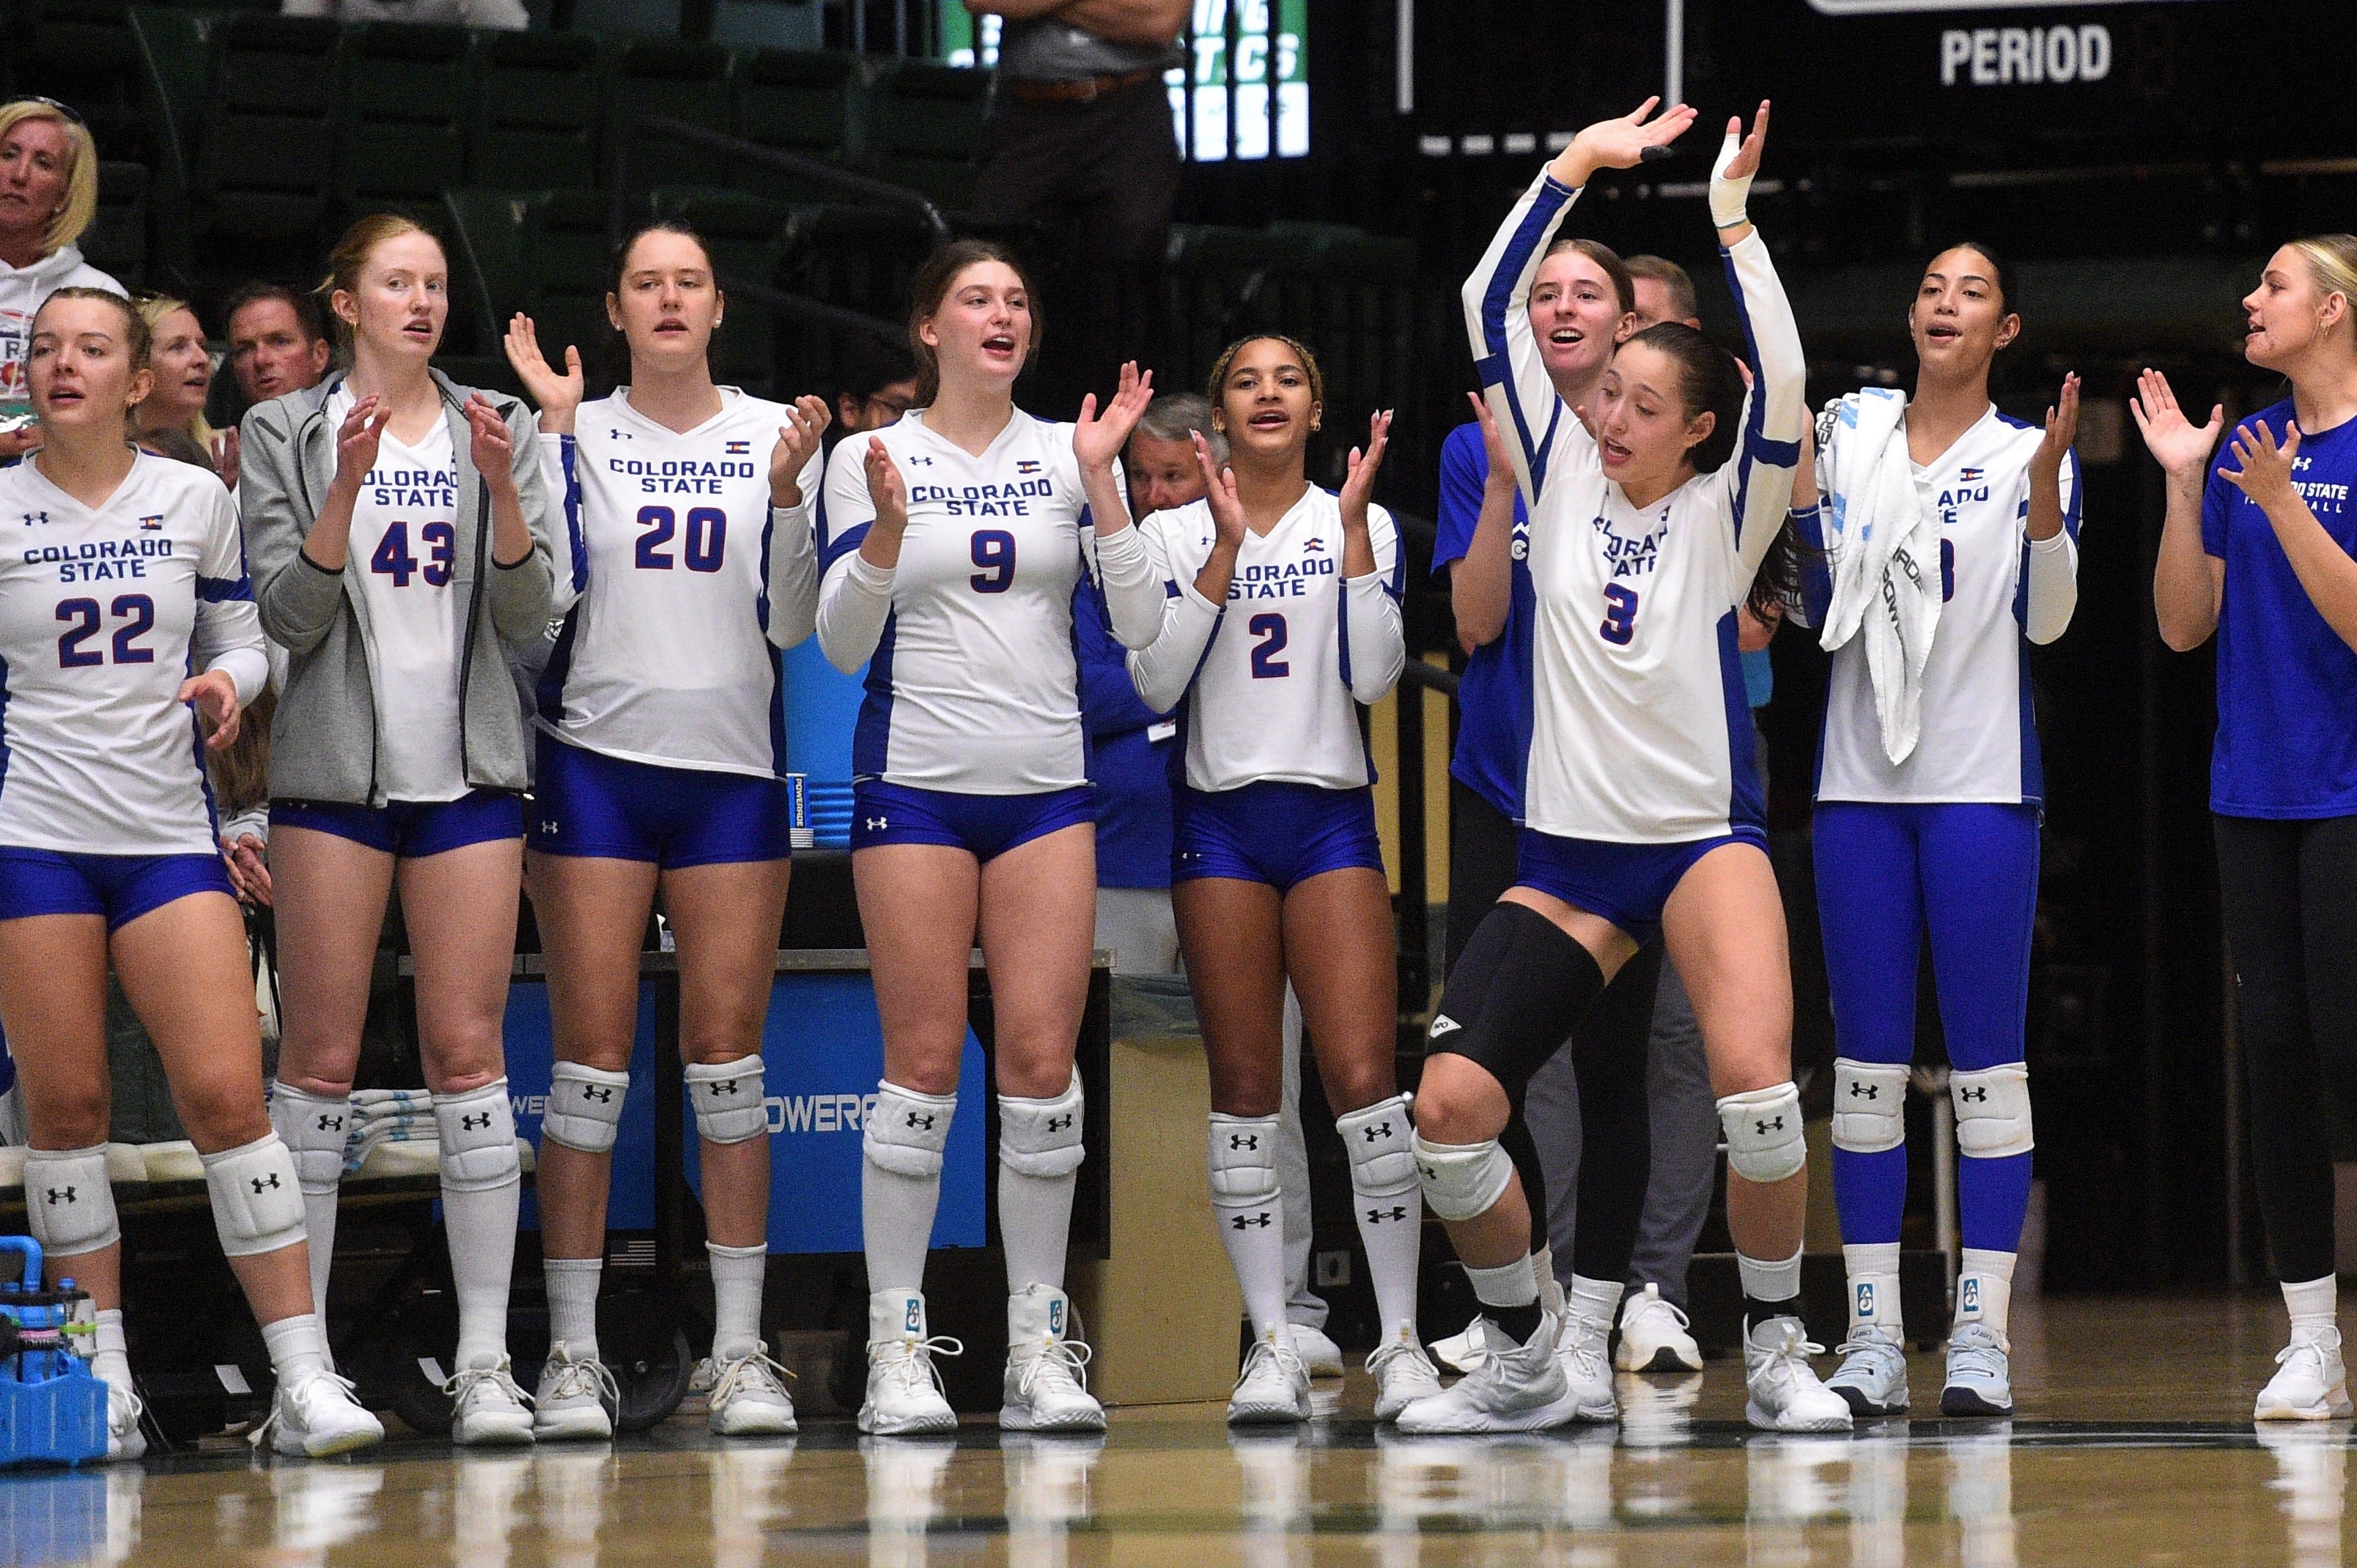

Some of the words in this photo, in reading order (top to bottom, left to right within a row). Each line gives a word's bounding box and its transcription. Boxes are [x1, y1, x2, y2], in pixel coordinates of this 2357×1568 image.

[1941, 24, 2111, 86] PERIOD
[362, 470, 458, 488] OLORA
[610, 458, 754, 478] COLORADO
[375, 488, 454, 508] STATE
[641, 478, 723, 495] STATE
[912, 478, 1052, 503] COLORADO
[2307, 482, 2349, 500] STATE
[946, 500, 1030, 517] STATE
[635, 505, 727, 573] 20
[24, 539, 173, 565] COLORADO
[370, 521, 455, 588] 43
[970, 530, 1017, 593] 9
[59, 559, 147, 583] STATE
[1232, 558, 1334, 582] LORADO
[1228, 578, 1306, 600] STATE
[1599, 582, 1639, 646] 3
[55, 593, 155, 669] 22
[1249, 613, 1290, 679] 2
[795, 777, 803, 827] POWERADE
